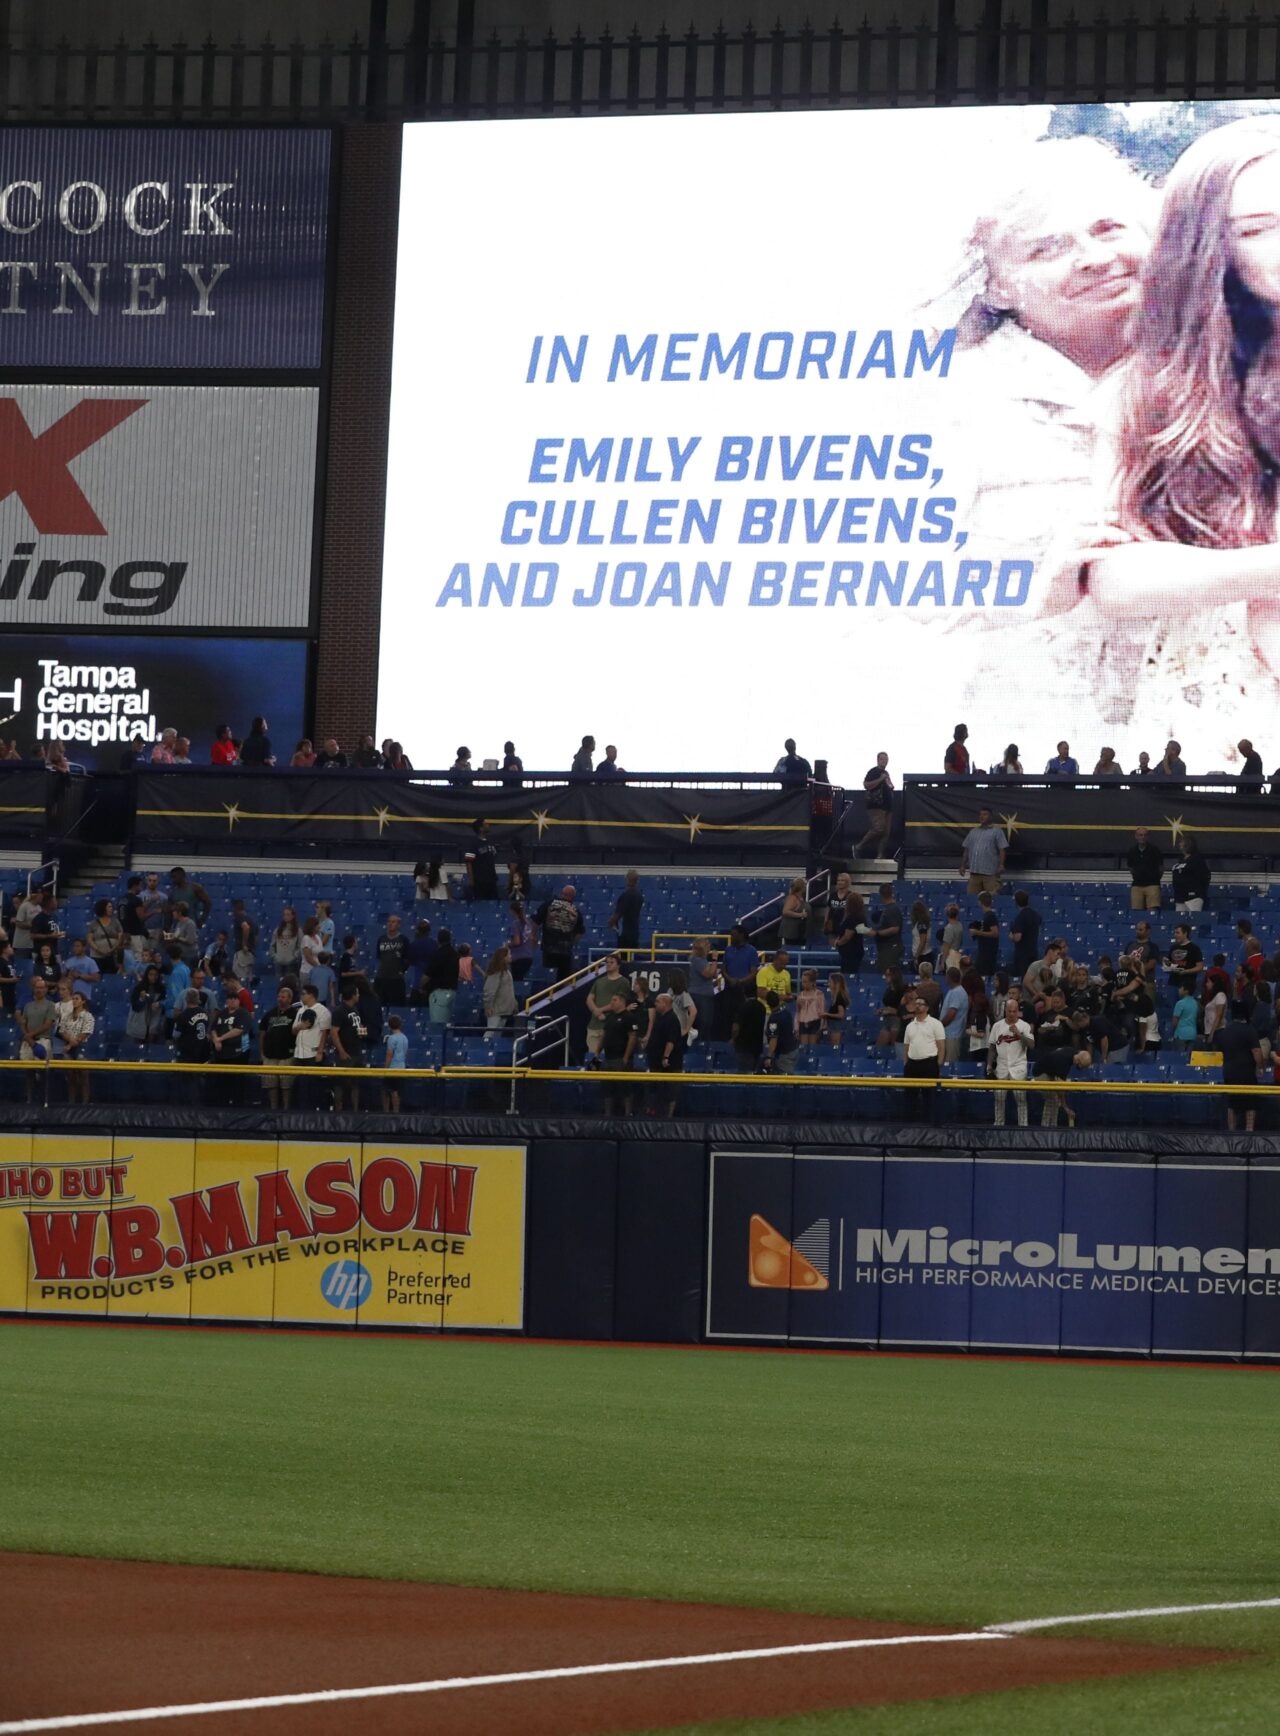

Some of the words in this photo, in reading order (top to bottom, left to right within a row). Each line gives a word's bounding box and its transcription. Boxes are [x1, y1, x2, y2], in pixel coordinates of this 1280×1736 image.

[526, 335, 588, 383] IN
[607, 329, 957, 383] MEMORIAM
[528, 437, 702, 483] EMILY
[714, 433, 944, 489] BIVENS,
[499, 499, 724, 545] CULLEN
[738, 497, 969, 552] BIVENS,
[435, 562, 560, 607] AND
[573, 561, 731, 607] JOAN
[749, 560, 1035, 607] BERNARD
[38, 660, 136, 692] Tampa
[37, 689, 149, 716] General
[60, 1164, 128, 1200] BUT
[41, 1273, 175, 1300] PRODUCTS
[186, 1259, 233, 1284] FOR
[242, 1246, 291, 1270] THE
[301, 1236, 466, 1258] WORKPLACE
[327, 1262, 367, 1308] hp
[387, 1265, 471, 1290] Preferred
[856, 1267, 917, 1286] HIGH
[922, 1268, 1083, 1291] PERFORMANCE
[1090, 1275, 1190, 1294] MEDICAL
[387, 1289, 453, 1306] Partner
